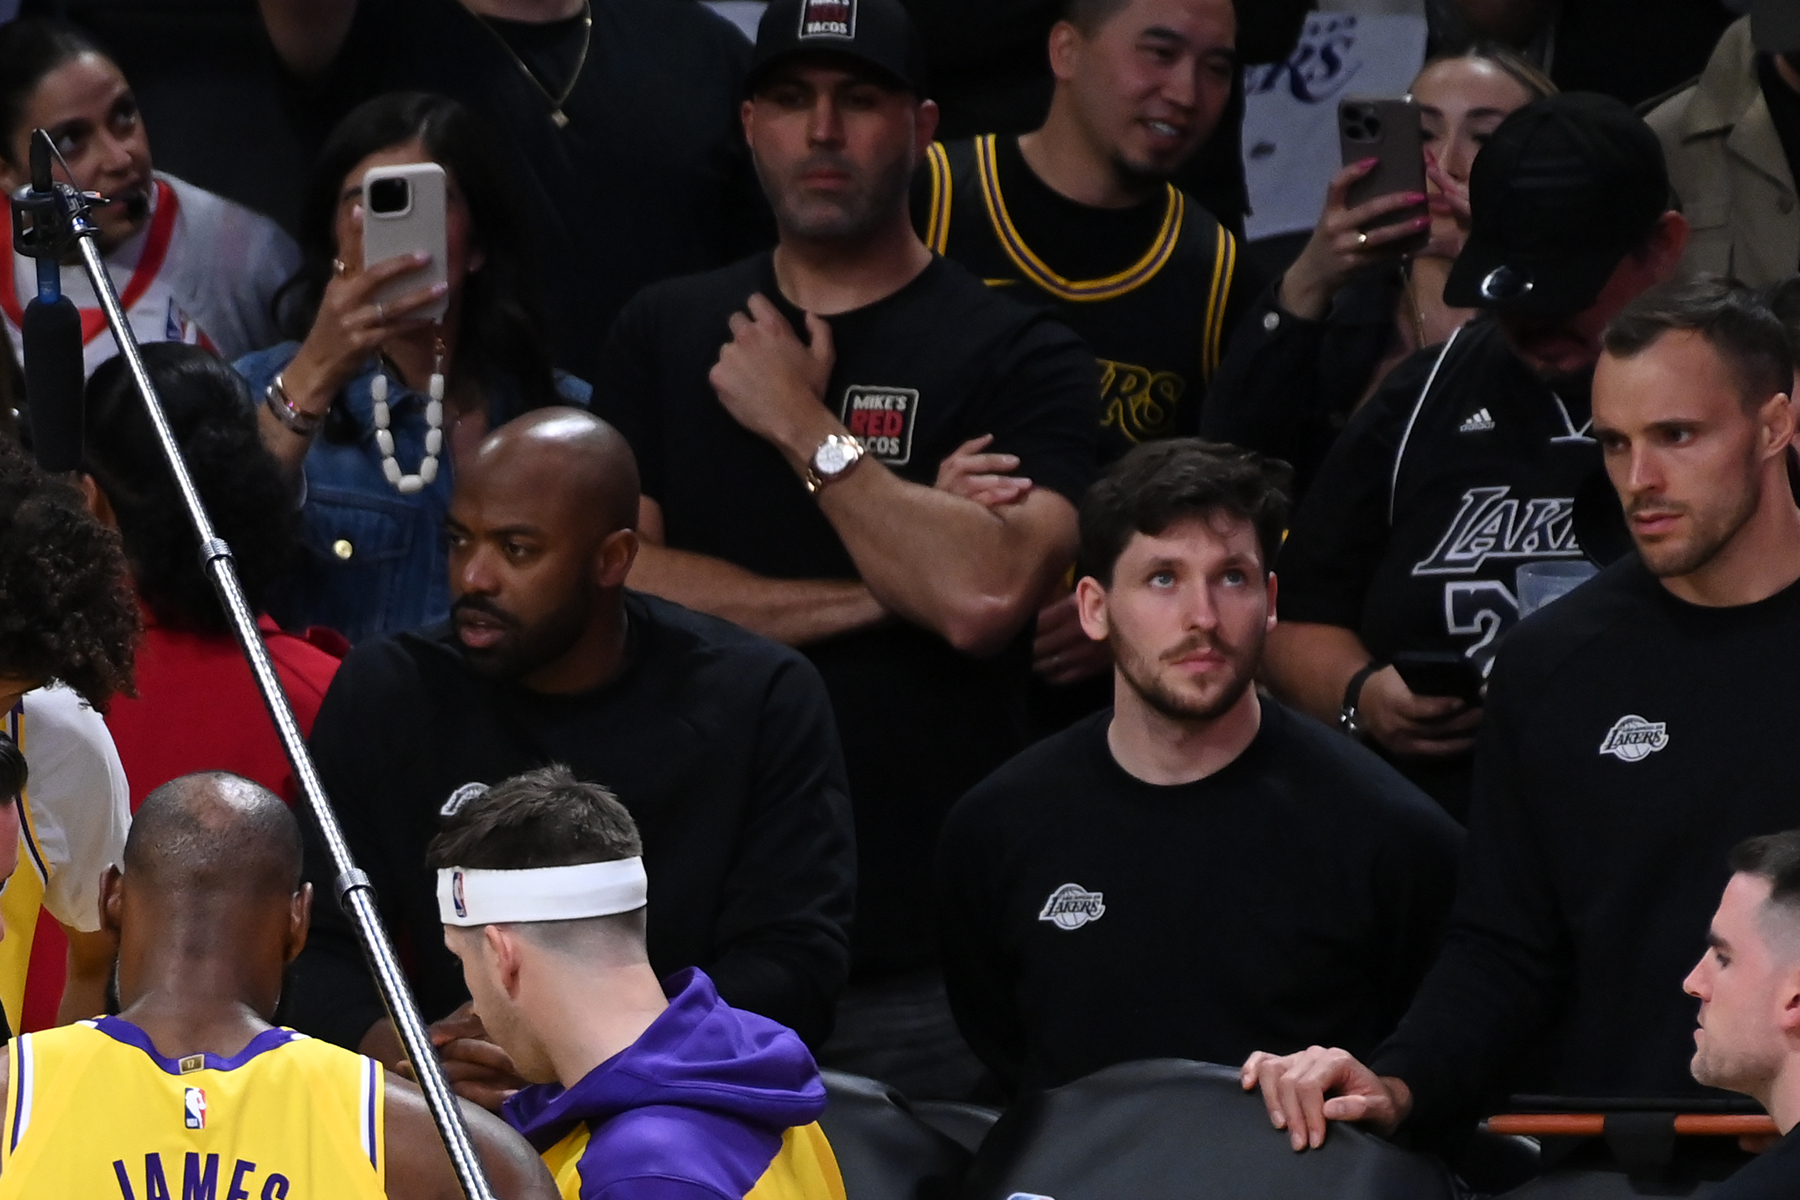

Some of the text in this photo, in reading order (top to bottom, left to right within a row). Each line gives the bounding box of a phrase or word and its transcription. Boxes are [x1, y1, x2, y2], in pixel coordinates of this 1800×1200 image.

[851, 409, 904, 438] RED
[852, 436, 901, 455] ACOS
[1411, 485, 1584, 577] LAK
[1042, 896, 1103, 918] LAKERS
